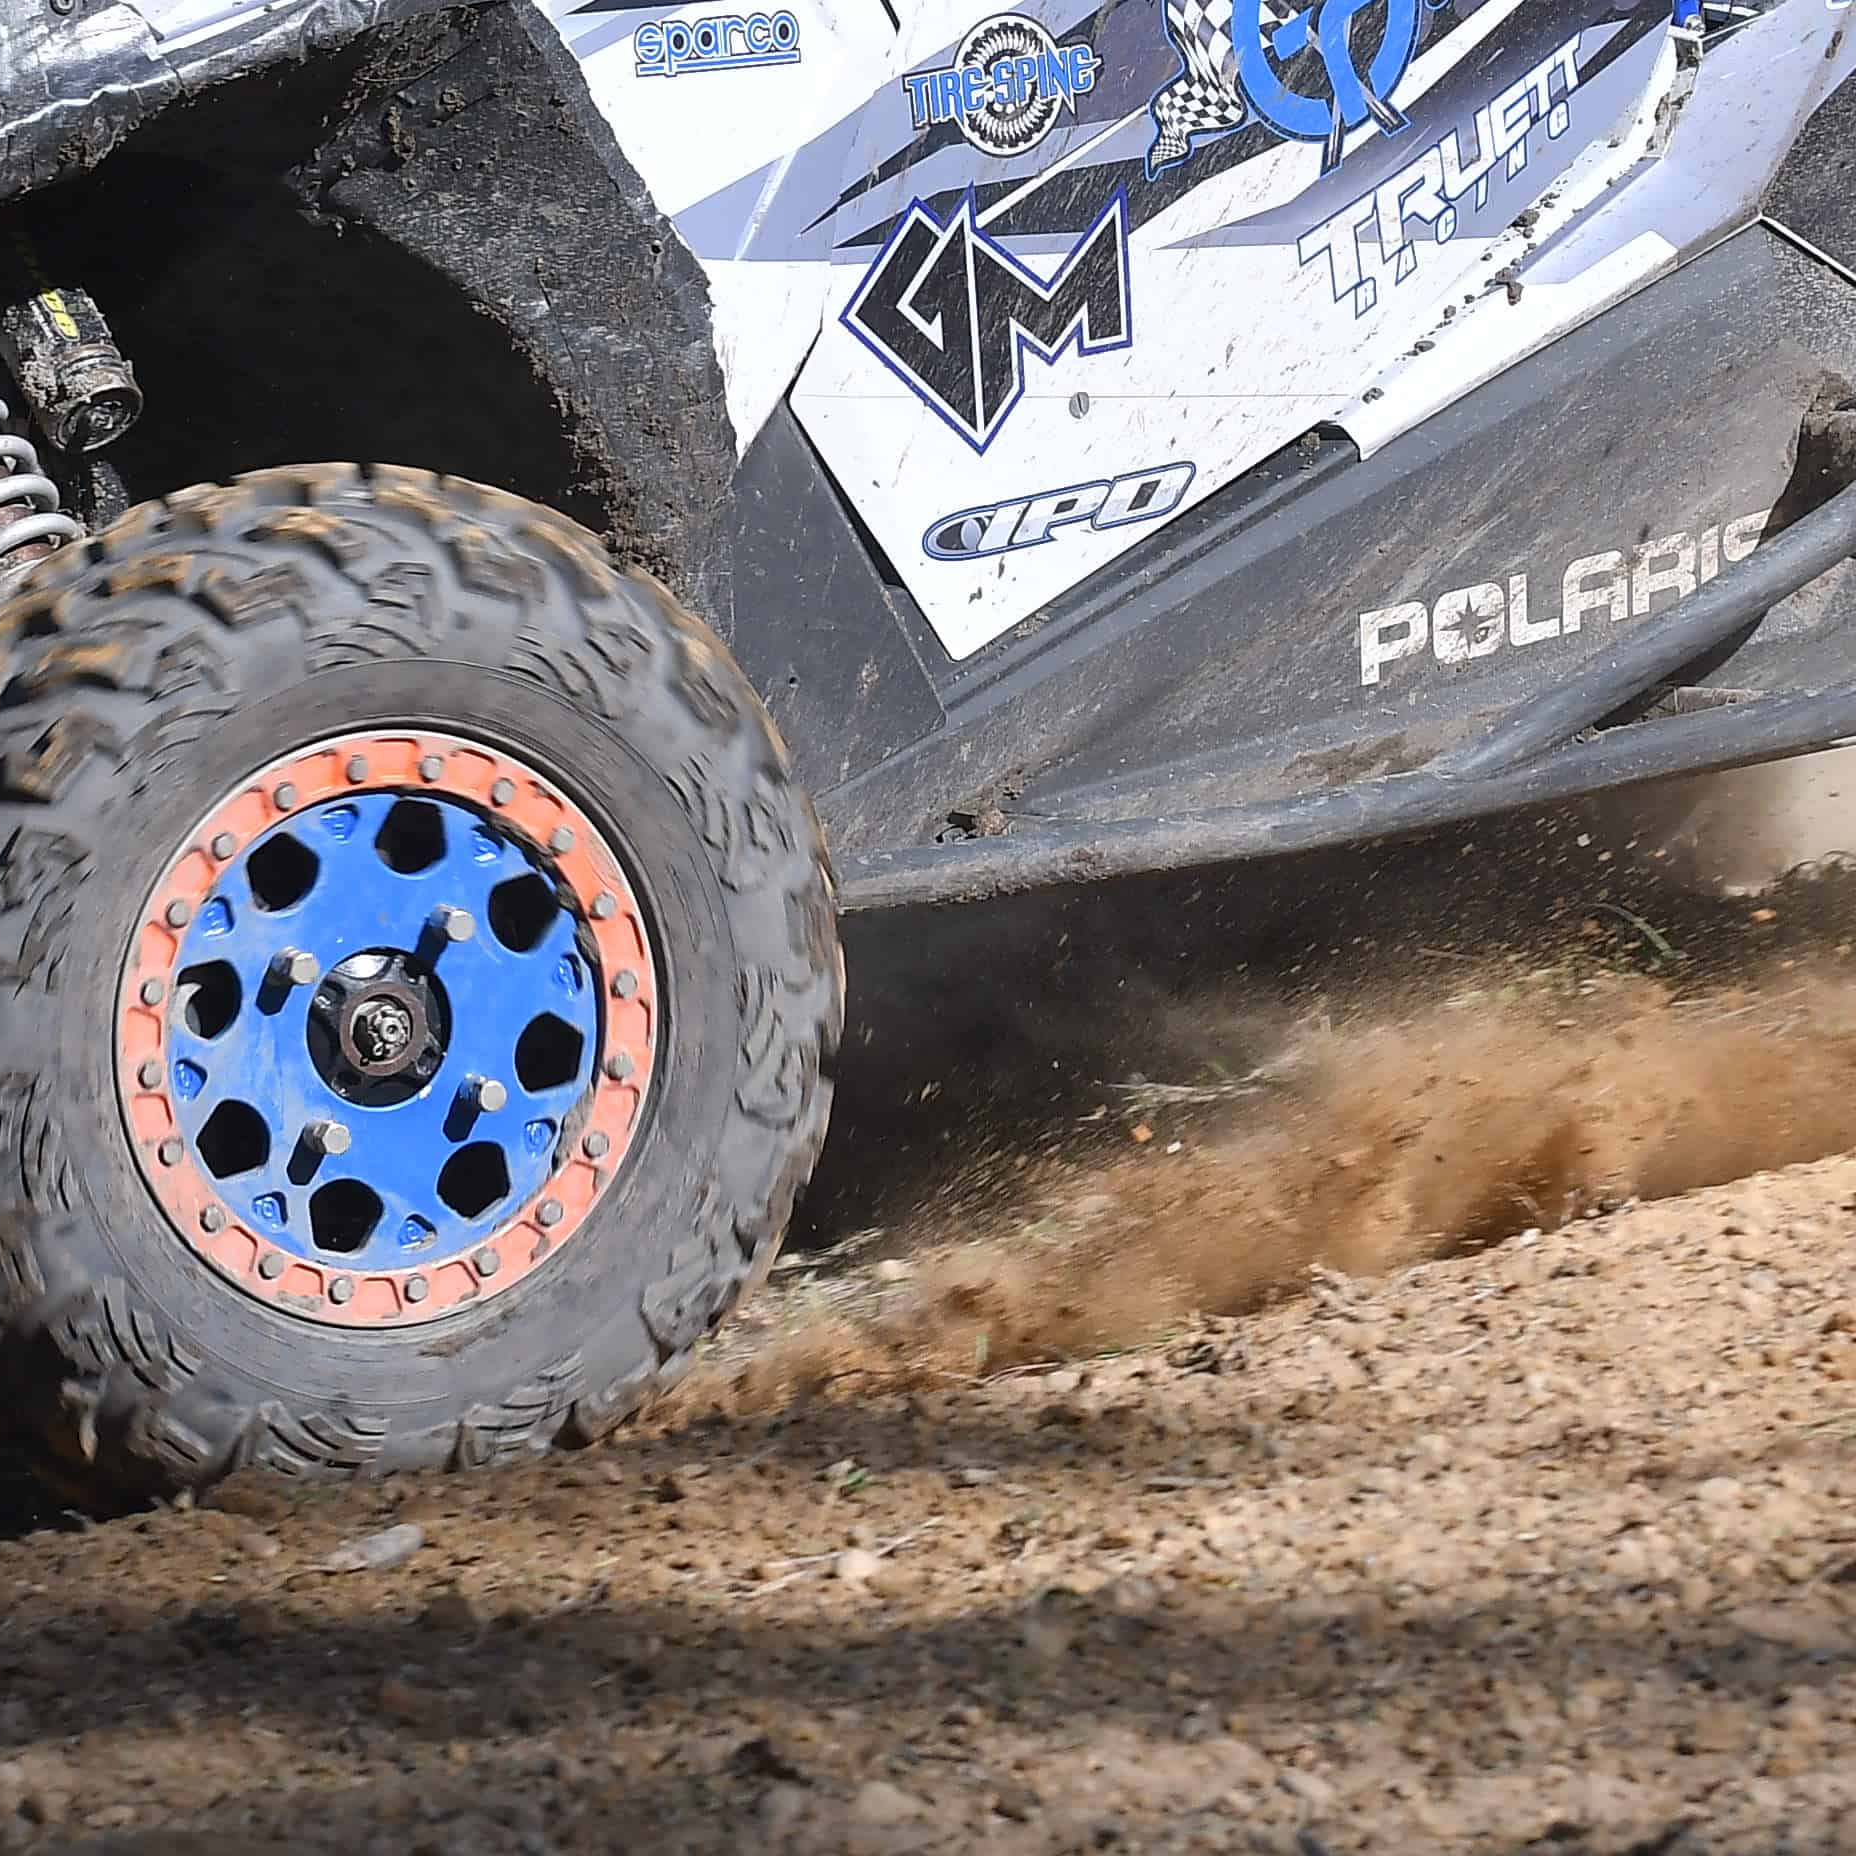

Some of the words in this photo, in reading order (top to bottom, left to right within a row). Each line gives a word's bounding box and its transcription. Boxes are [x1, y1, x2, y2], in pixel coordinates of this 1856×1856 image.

[634, 10, 801, 77] sparco
[905, 66, 991, 125] TIRE
[993, 44, 1103, 115] SPINE
[1297, 32, 1582, 303] TRUETT
